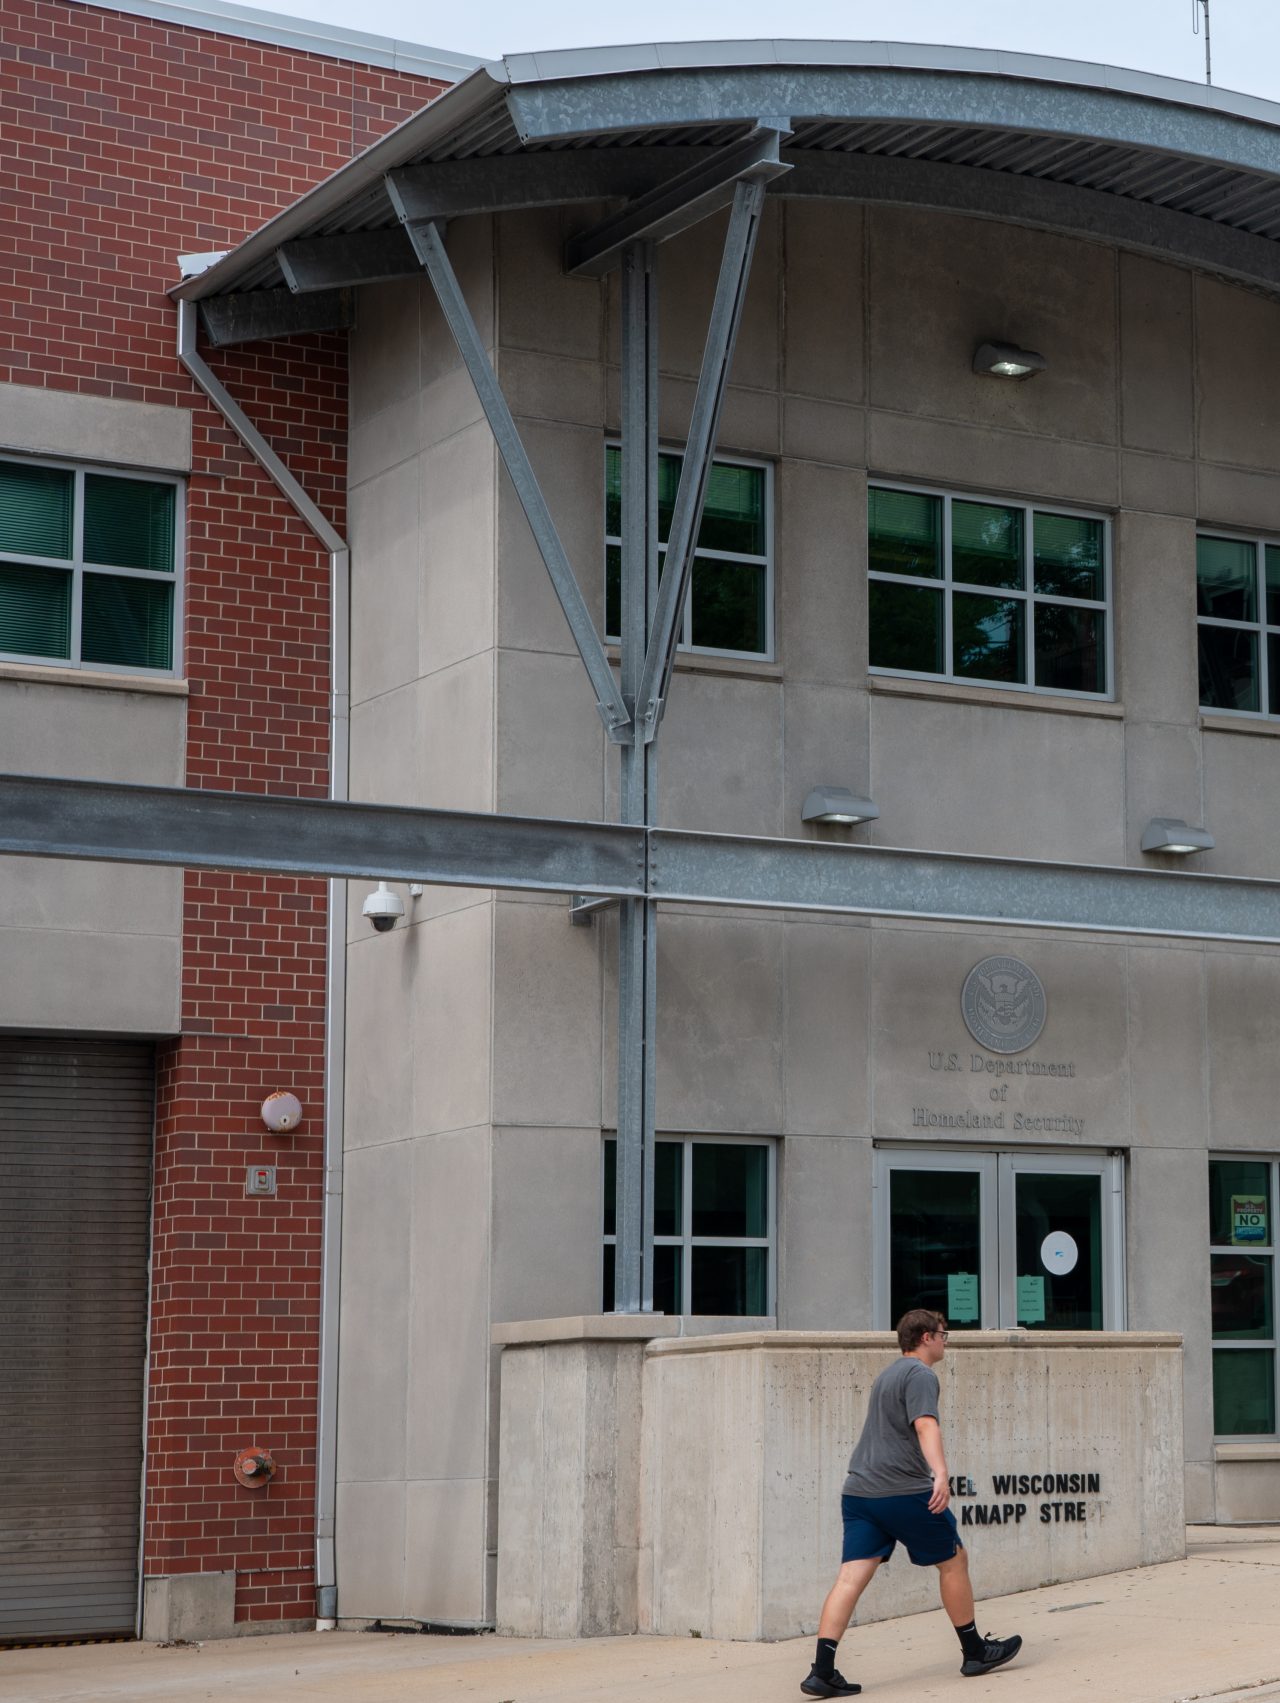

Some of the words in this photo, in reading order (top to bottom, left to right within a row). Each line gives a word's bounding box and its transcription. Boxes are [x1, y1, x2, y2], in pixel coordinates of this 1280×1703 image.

[928, 1052, 962, 1072] U.S.
[970, 1054, 1076, 1078] Department
[989, 1084, 1008, 1102] of
[912, 1107, 1005, 1129] Homeland
[1013, 1112, 1086, 1136] Security
[1240, 1214, 1260, 1226] NO
[992, 1473, 1100, 1496] WISCONSIN
[961, 1503, 1027, 1525] KNAPP
